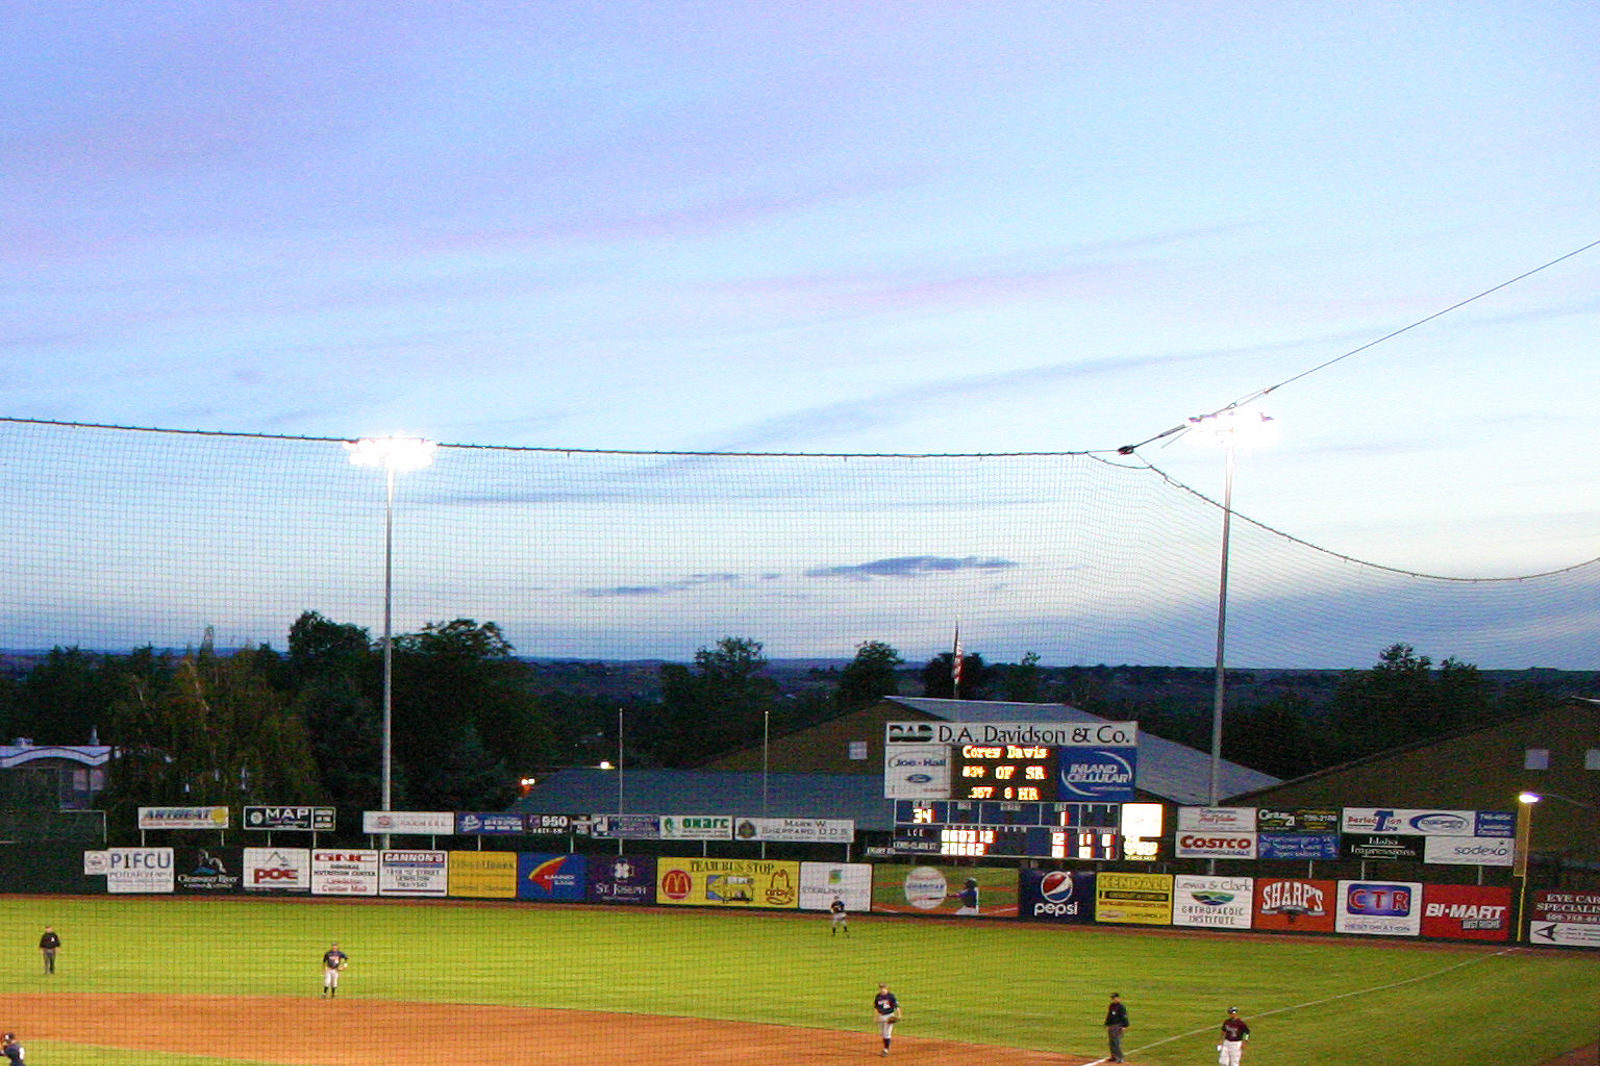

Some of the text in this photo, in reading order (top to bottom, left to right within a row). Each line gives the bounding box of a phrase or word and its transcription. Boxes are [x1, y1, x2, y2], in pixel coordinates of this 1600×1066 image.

[938, 724, 1130, 744] D.A. Davidson & Co.
[1006, 744, 1050, 759] Davis
[995, 765, 1016, 780] OF
[1070, 763, 1118, 774] INLAND
[1067, 773, 1130, 783] CELLULAR
[265, 807, 310, 820] MAP
[541, 815, 568, 828] 950
[1180, 834, 1252, 850] COSTCO
[110, 853, 171, 869] P1FCU
[314, 853, 378, 863] GNC
[384, 853, 444, 863] CANNON'S
[690, 859, 723, 873] TEAM
[746, 863, 775, 875] STOP
[1099, 875, 1170, 891] KENDALL
[1261, 880, 1324, 912] SHARP'S
[1546, 893, 1574, 903] EYE
[1033, 902, 1078, 917] pepsi
